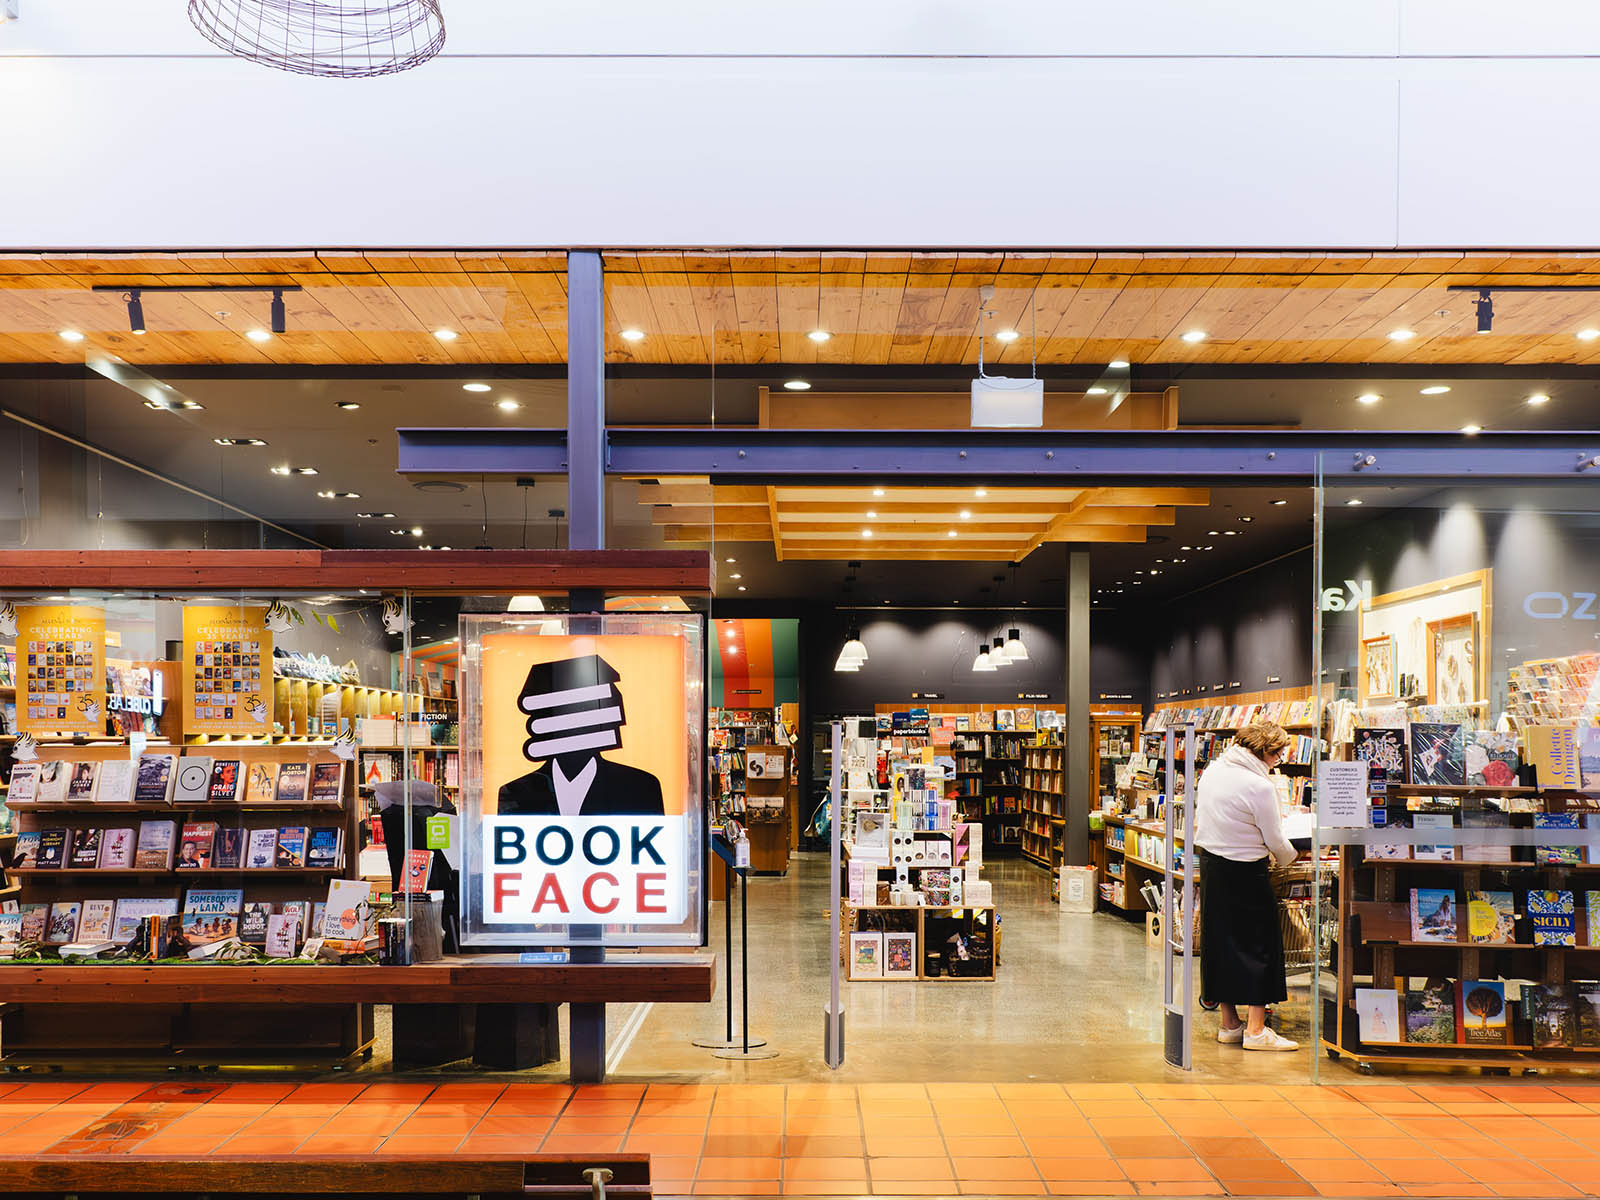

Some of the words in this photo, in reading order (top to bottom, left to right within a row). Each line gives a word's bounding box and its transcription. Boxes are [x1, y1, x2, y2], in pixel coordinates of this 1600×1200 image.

[29, 626, 93, 634] CELEBRATING
[196, 626, 260, 634] CELEBRATING
[893, 728, 927, 736] paperblanks
[493, 825, 667, 866] BOOK
[493, 871, 668, 914] FACE
[189, 895, 238, 903] SOMEBODY'S
[199, 903, 225, 912] LAND
[327, 914, 356, 926] Everything
[1533, 916, 1571, 927] SICILY
[1470, 1028, 1486, 1037] Tree
[1486, 1028, 1502, 1037] Atlas
